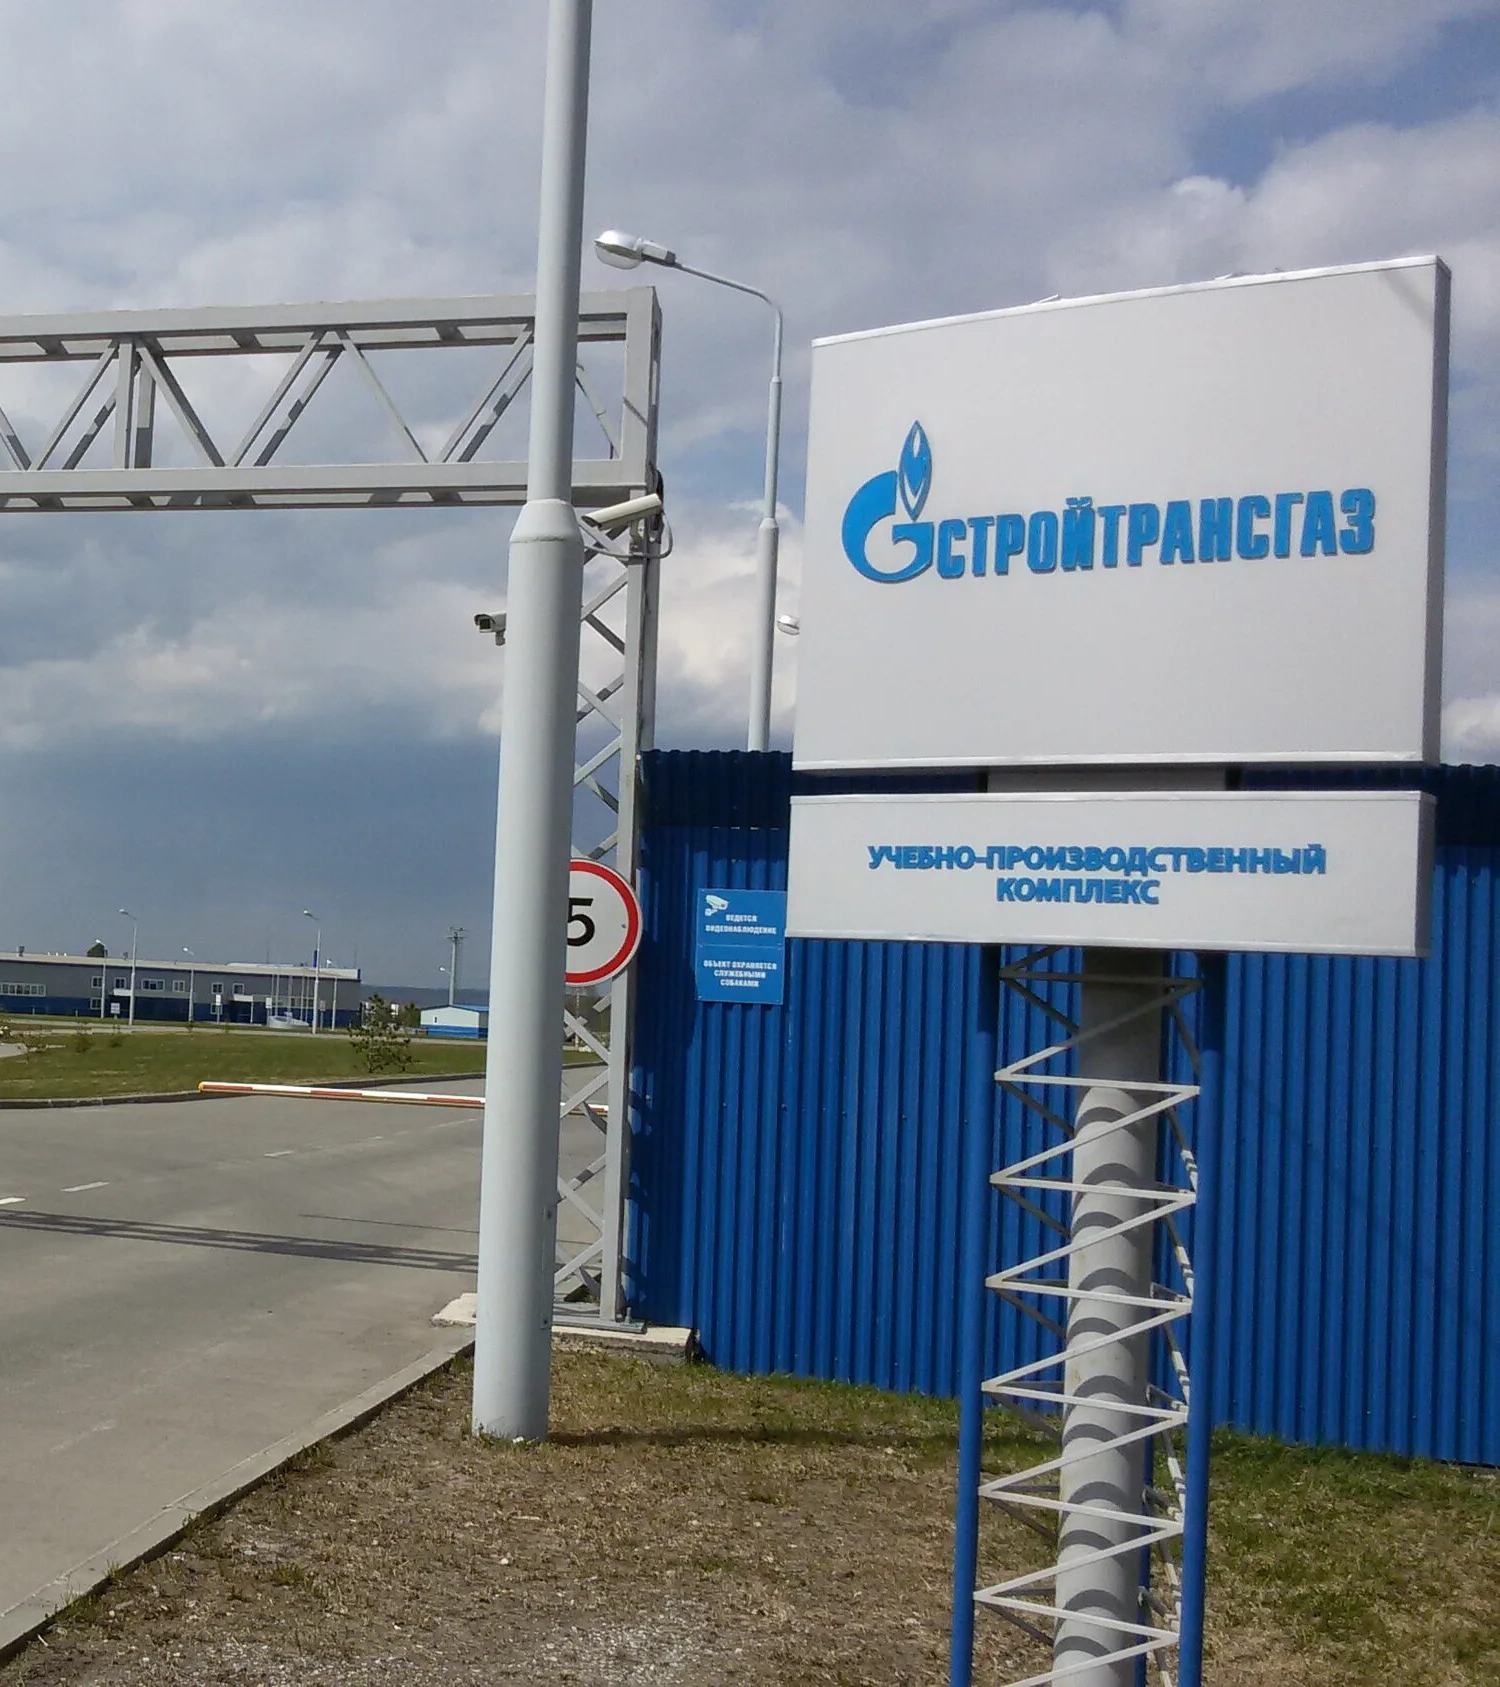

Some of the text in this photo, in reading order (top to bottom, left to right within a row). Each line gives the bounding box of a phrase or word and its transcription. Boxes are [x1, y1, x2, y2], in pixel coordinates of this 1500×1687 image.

[936, 487, 1376, 580] СТРОЙТРАНСГАЗ
[867, 844, 1327, 876] УЧЕБНО-ПРОИЗВОДСТВЕННЫЙ
[996, 876, 1161, 905] КОМПЛЕКС
[567, 897, 596, 947] 5
